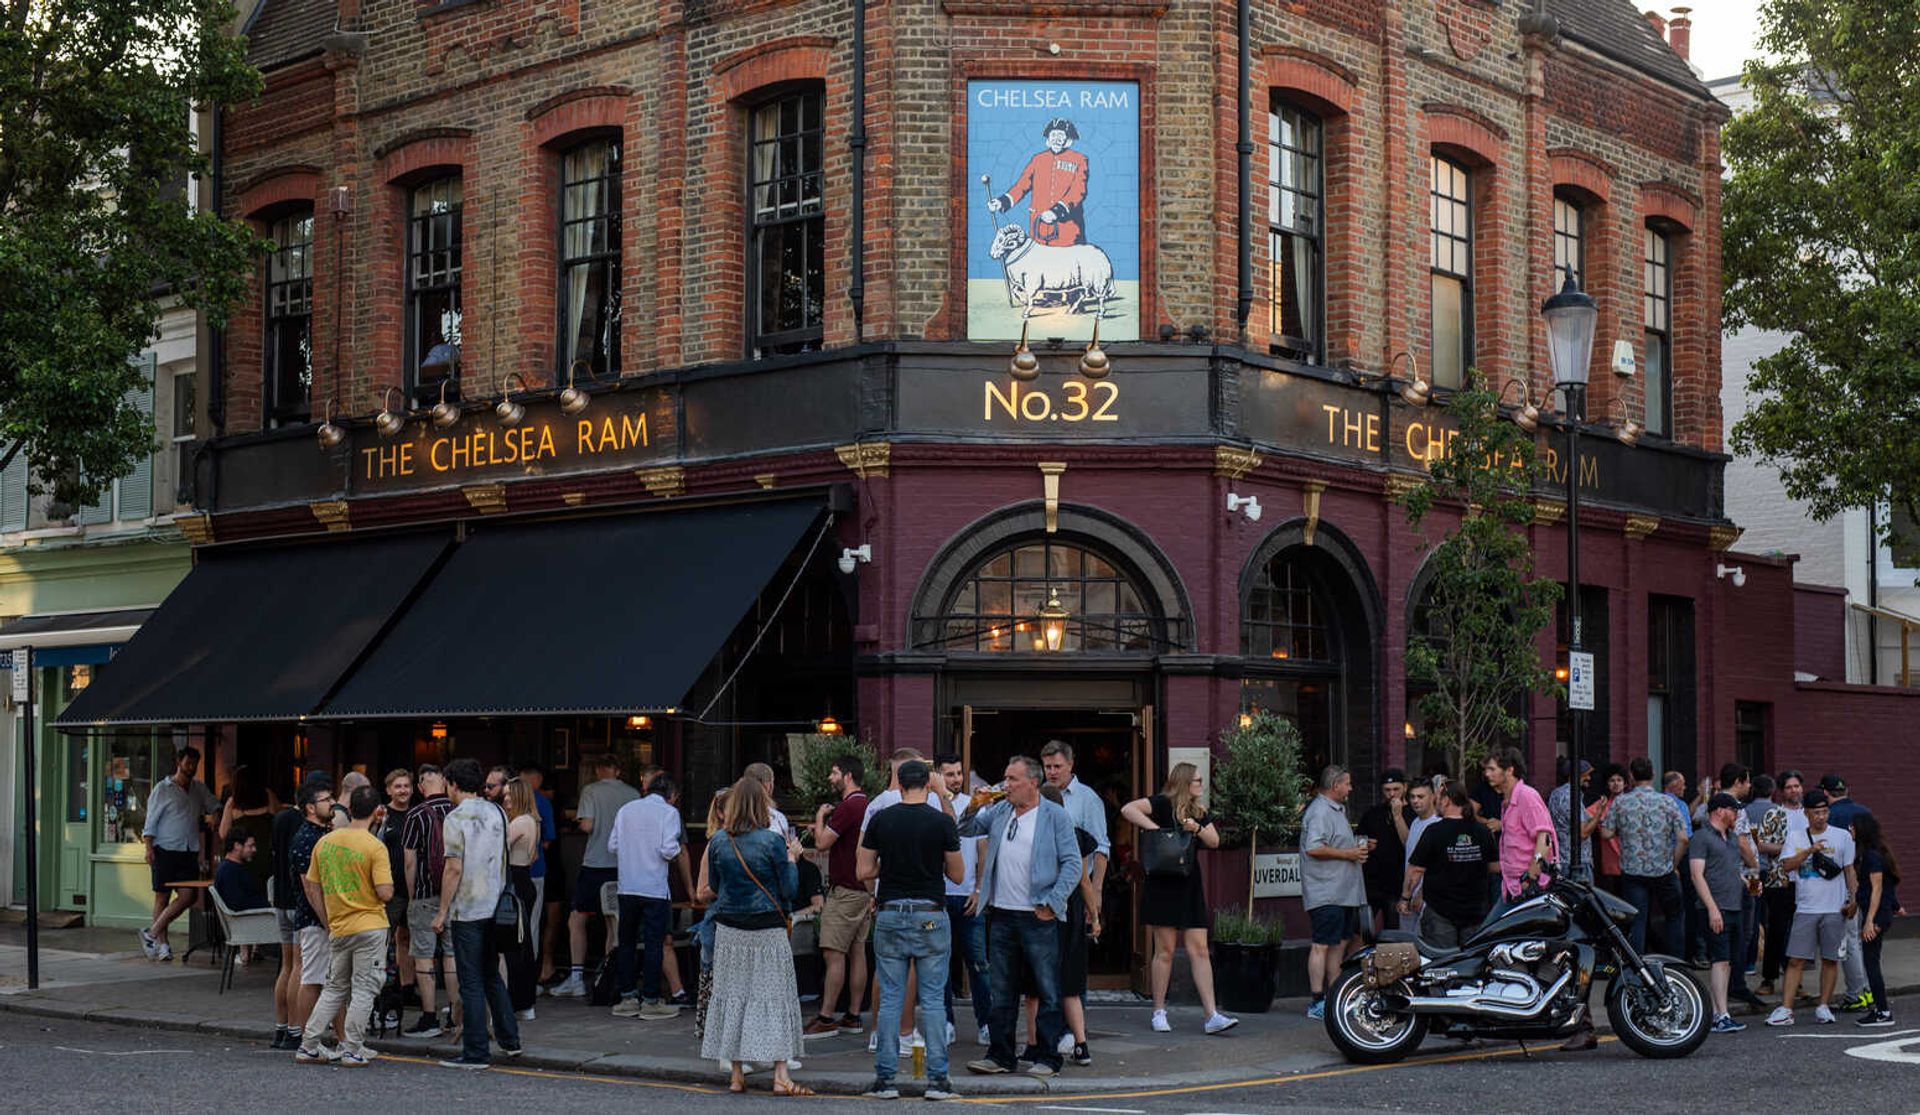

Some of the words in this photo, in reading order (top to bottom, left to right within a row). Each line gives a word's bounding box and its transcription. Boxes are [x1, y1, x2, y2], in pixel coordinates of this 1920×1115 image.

[977, 88, 1072, 109] CHELSEA
[1080, 89, 1129, 109] RAM
[983, 379, 1119, 423] No.32
[362, 442, 415, 480] THE
[430, 424, 556, 472] CHELSEA
[578, 412, 649, 455] RAM
[1322, 403, 1381, 452] THE
